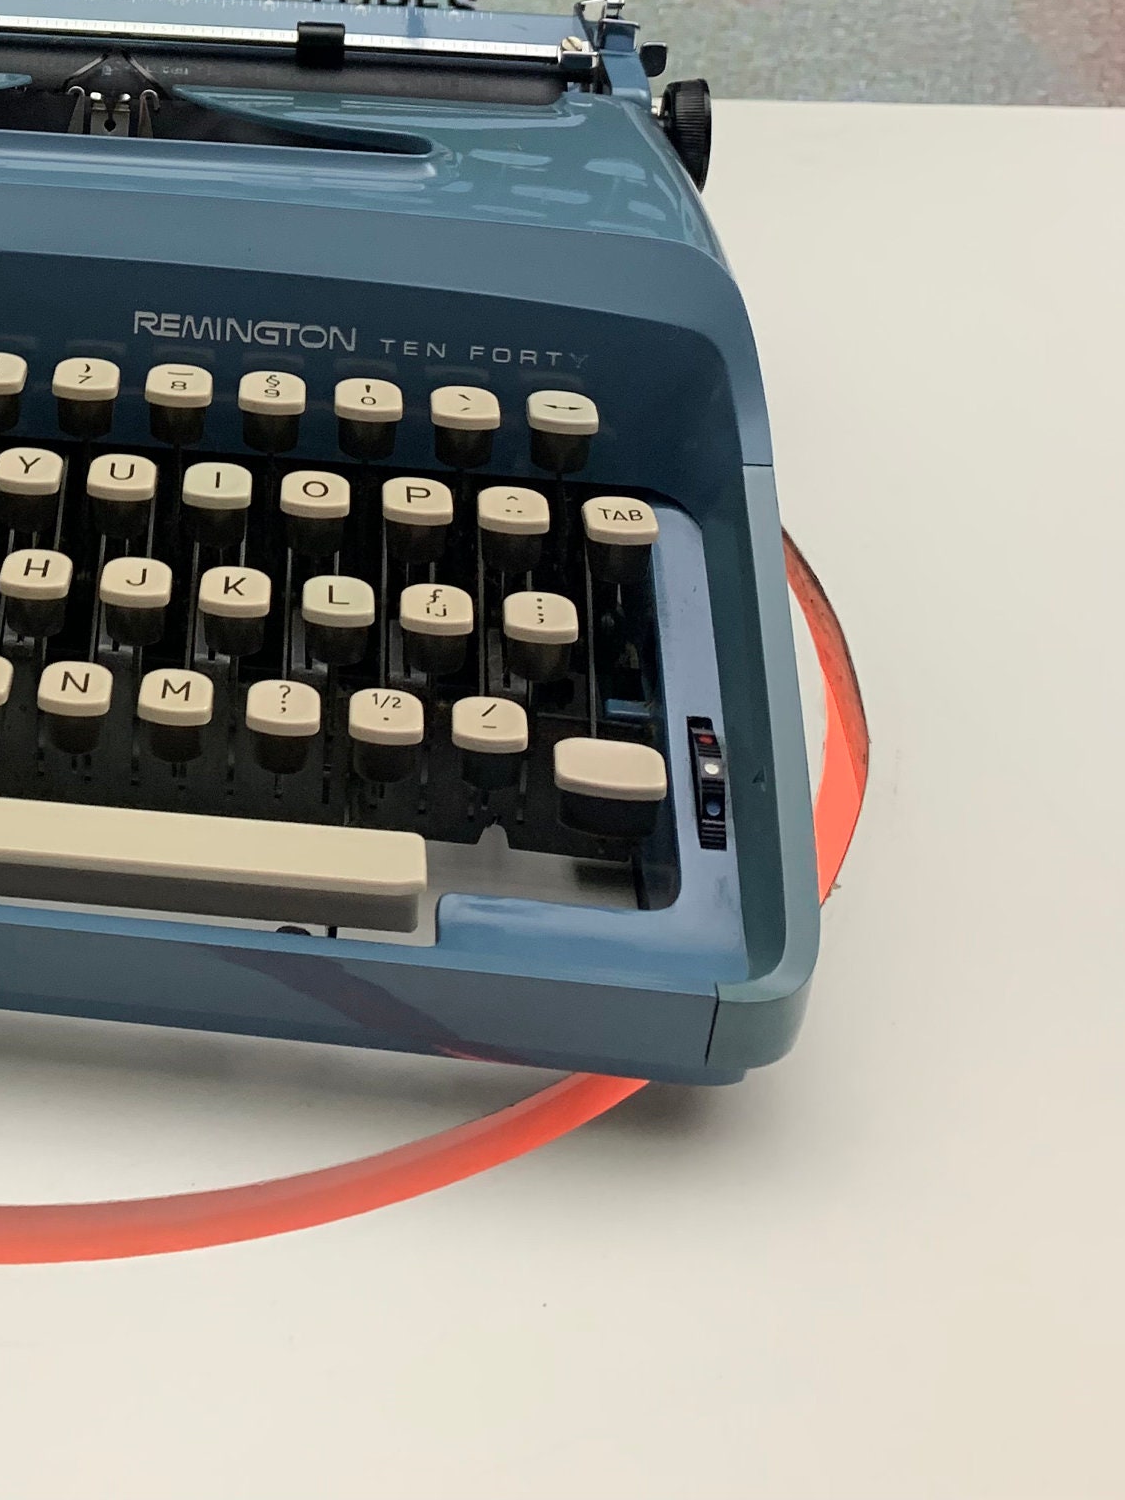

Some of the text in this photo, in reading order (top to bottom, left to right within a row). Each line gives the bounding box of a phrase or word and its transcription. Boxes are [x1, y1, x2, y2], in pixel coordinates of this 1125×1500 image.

[133, 310, 589, 369] REMINGTON TEN FORTY
[18, 455, 41, 475] Y
[109, 462, 135, 481] U
[302, 480, 329, 498] O
[405, 485, 432, 504] P
[597, 507, 644, 522] TAB
[23, 558, 51, 578] H
[125, 568, 148, 587] J
[223, 575, 247, 597] K
[328, 584, 350, 605] L
[60, 670, 90, 694] N
[161, 678, 192, 702] M
